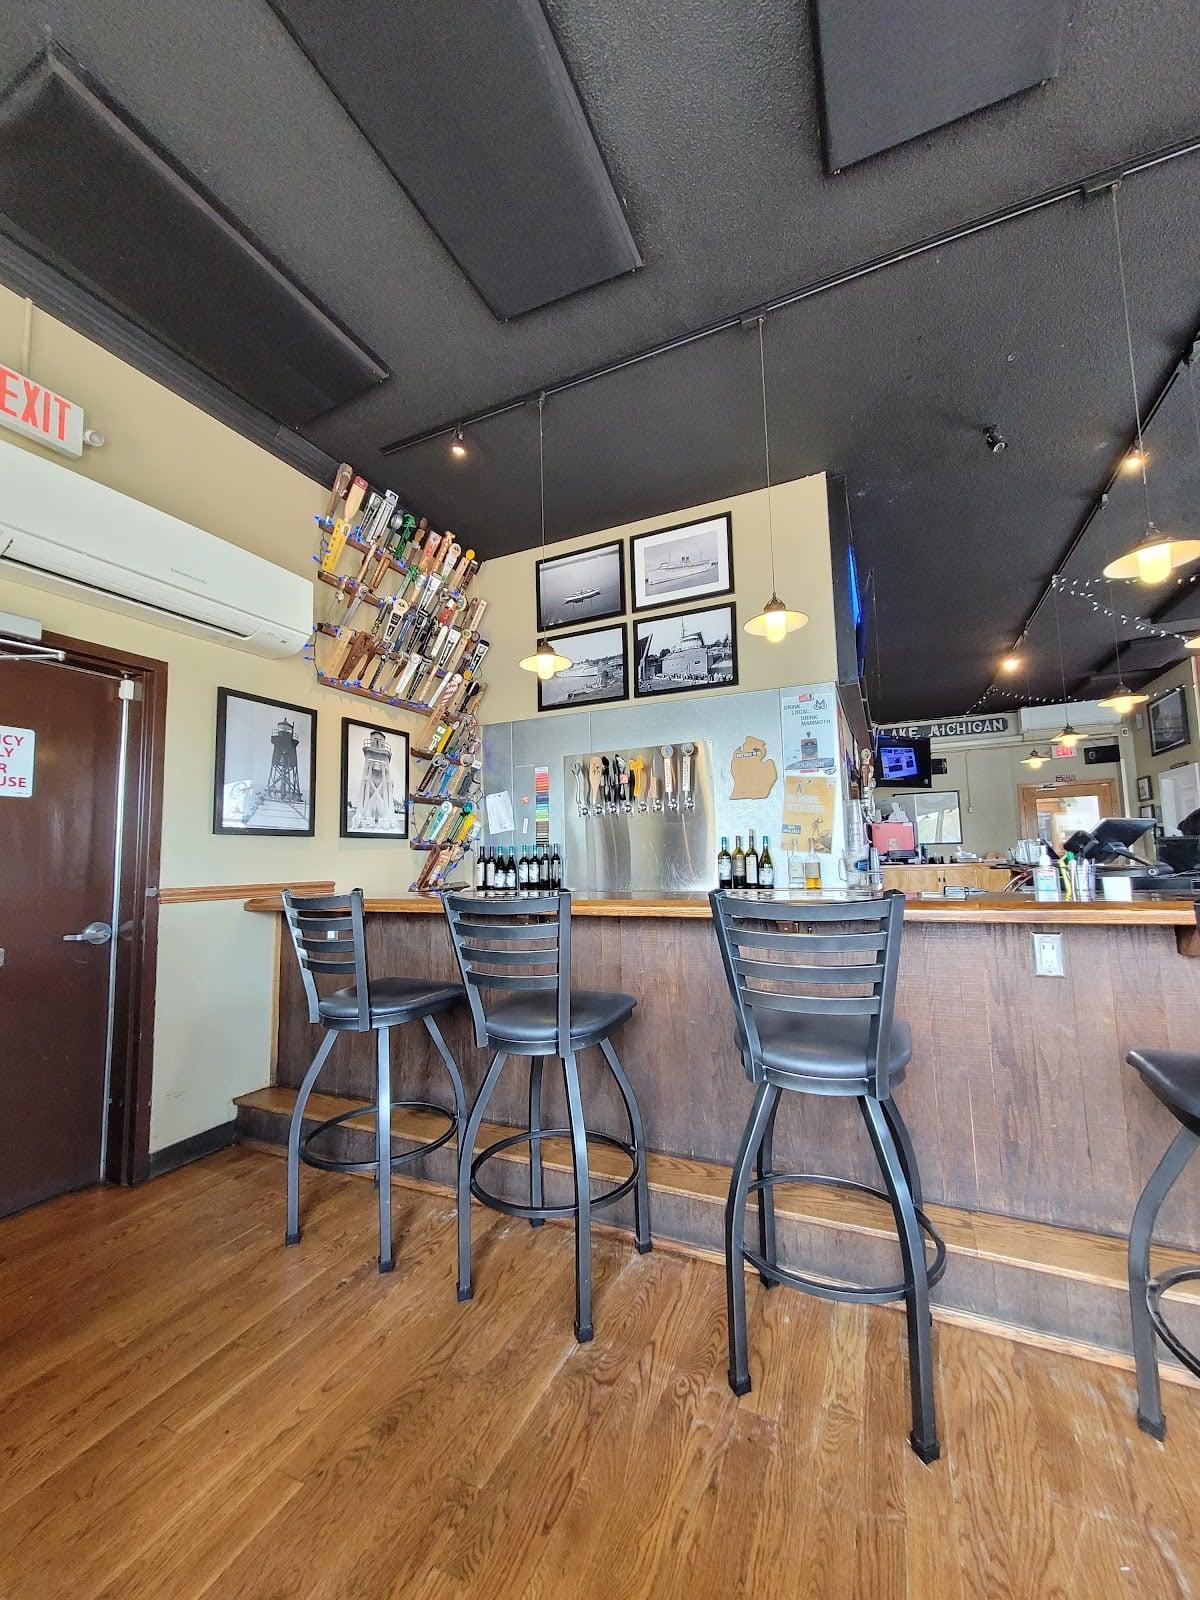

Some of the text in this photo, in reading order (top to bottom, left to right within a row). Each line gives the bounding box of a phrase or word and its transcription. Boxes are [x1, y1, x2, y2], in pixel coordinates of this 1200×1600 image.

[0, 367, 71, 441] EXIT
[929, 720, 1004, 737] MICHIGAN
[0, 734, 24, 746] CY
